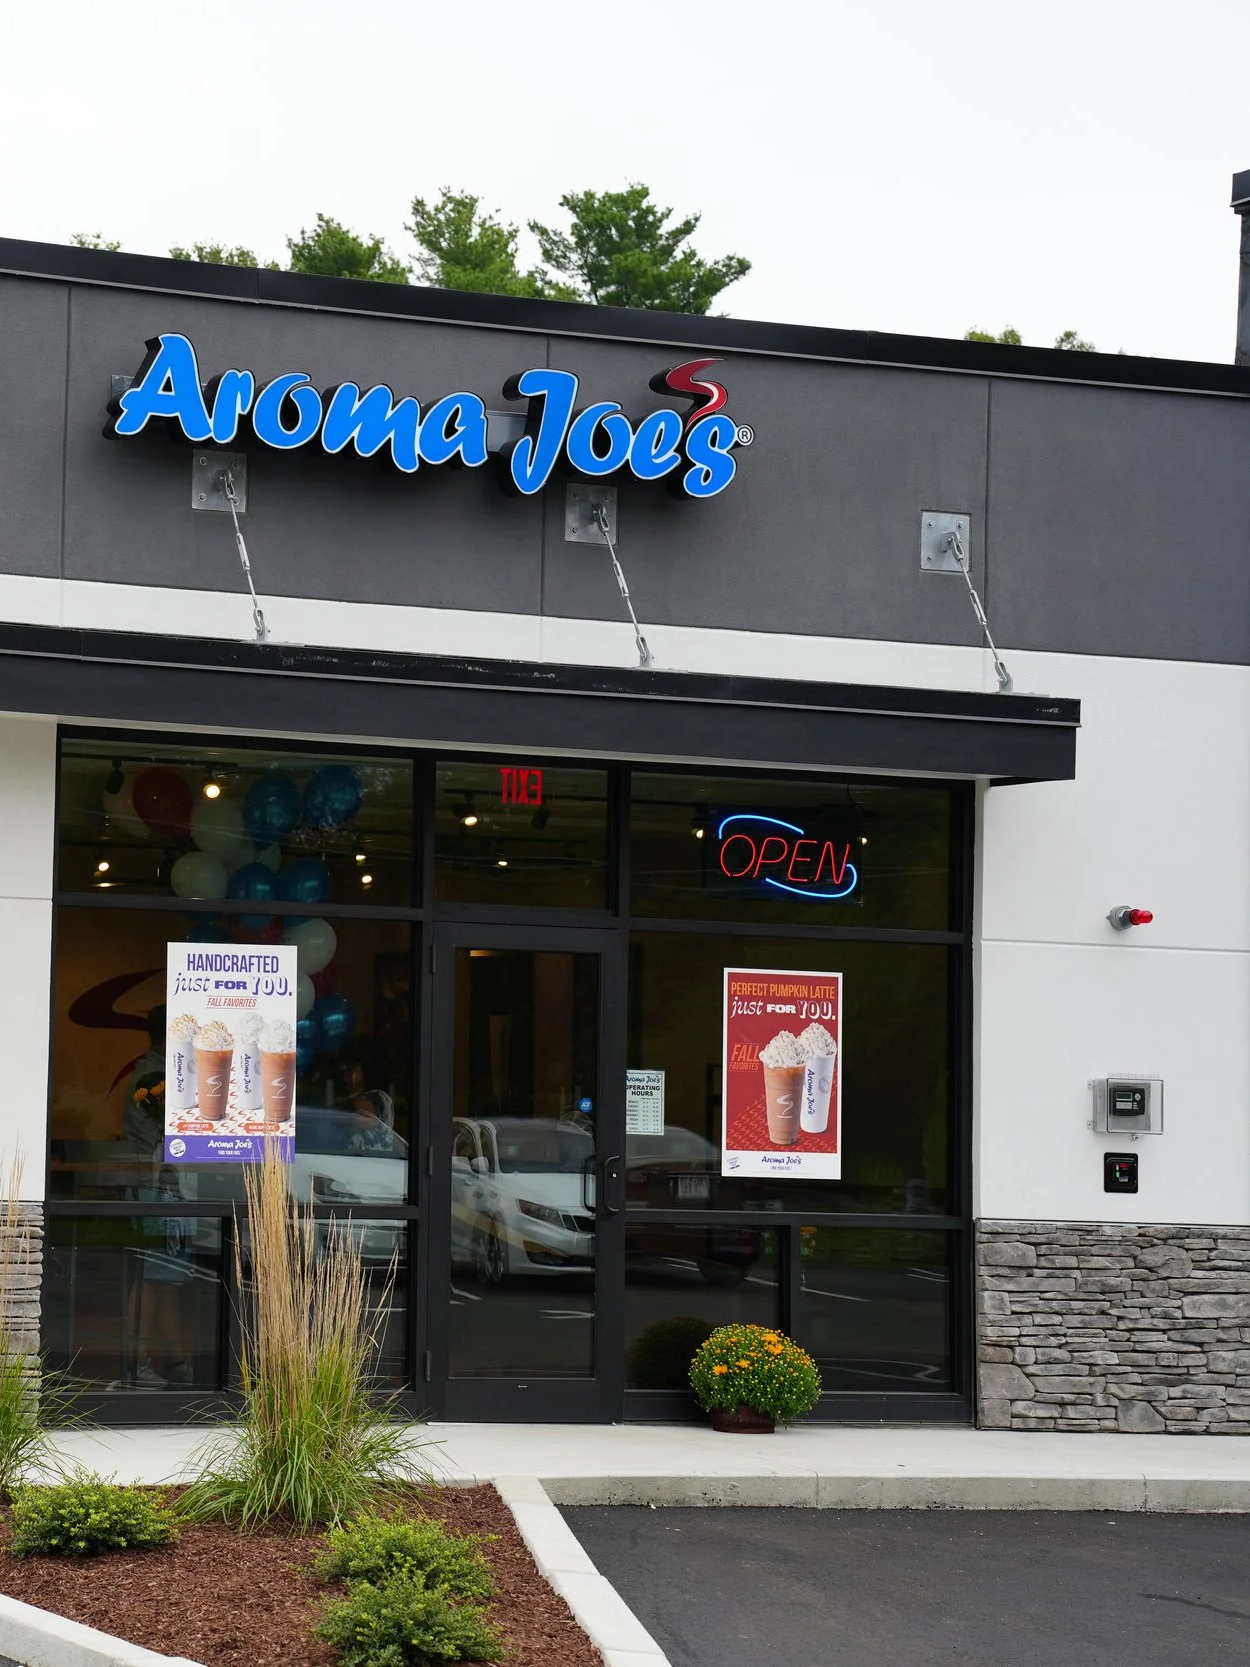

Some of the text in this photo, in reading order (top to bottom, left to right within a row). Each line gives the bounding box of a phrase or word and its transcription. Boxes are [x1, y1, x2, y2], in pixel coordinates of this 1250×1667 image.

[115, 333, 489, 474] Aroma
[720, 834, 850, 885] OPEN
[187, 953, 279, 974] HANDCRAFTED
[173, 972, 293, 996] just FOR YOU.
[731, 982, 835, 999] PERFECT PUMPKIN LATTE
[207, 997, 258, 1008] FALL FAVORITES
[730, 996, 836, 1020] just FOR YOU.
[731, 1044, 759, 1061] FALL
[176, 1052, 184, 1076] Aroma
[243, 1053, 252, 1077] Aroma
[729, 1061, 759, 1071] FAVORITES
[807, 1068, 815, 1096] Aroma
[207, 1139, 233, 1149] Aroma
[761, 1155, 785, 1164] Aroma
